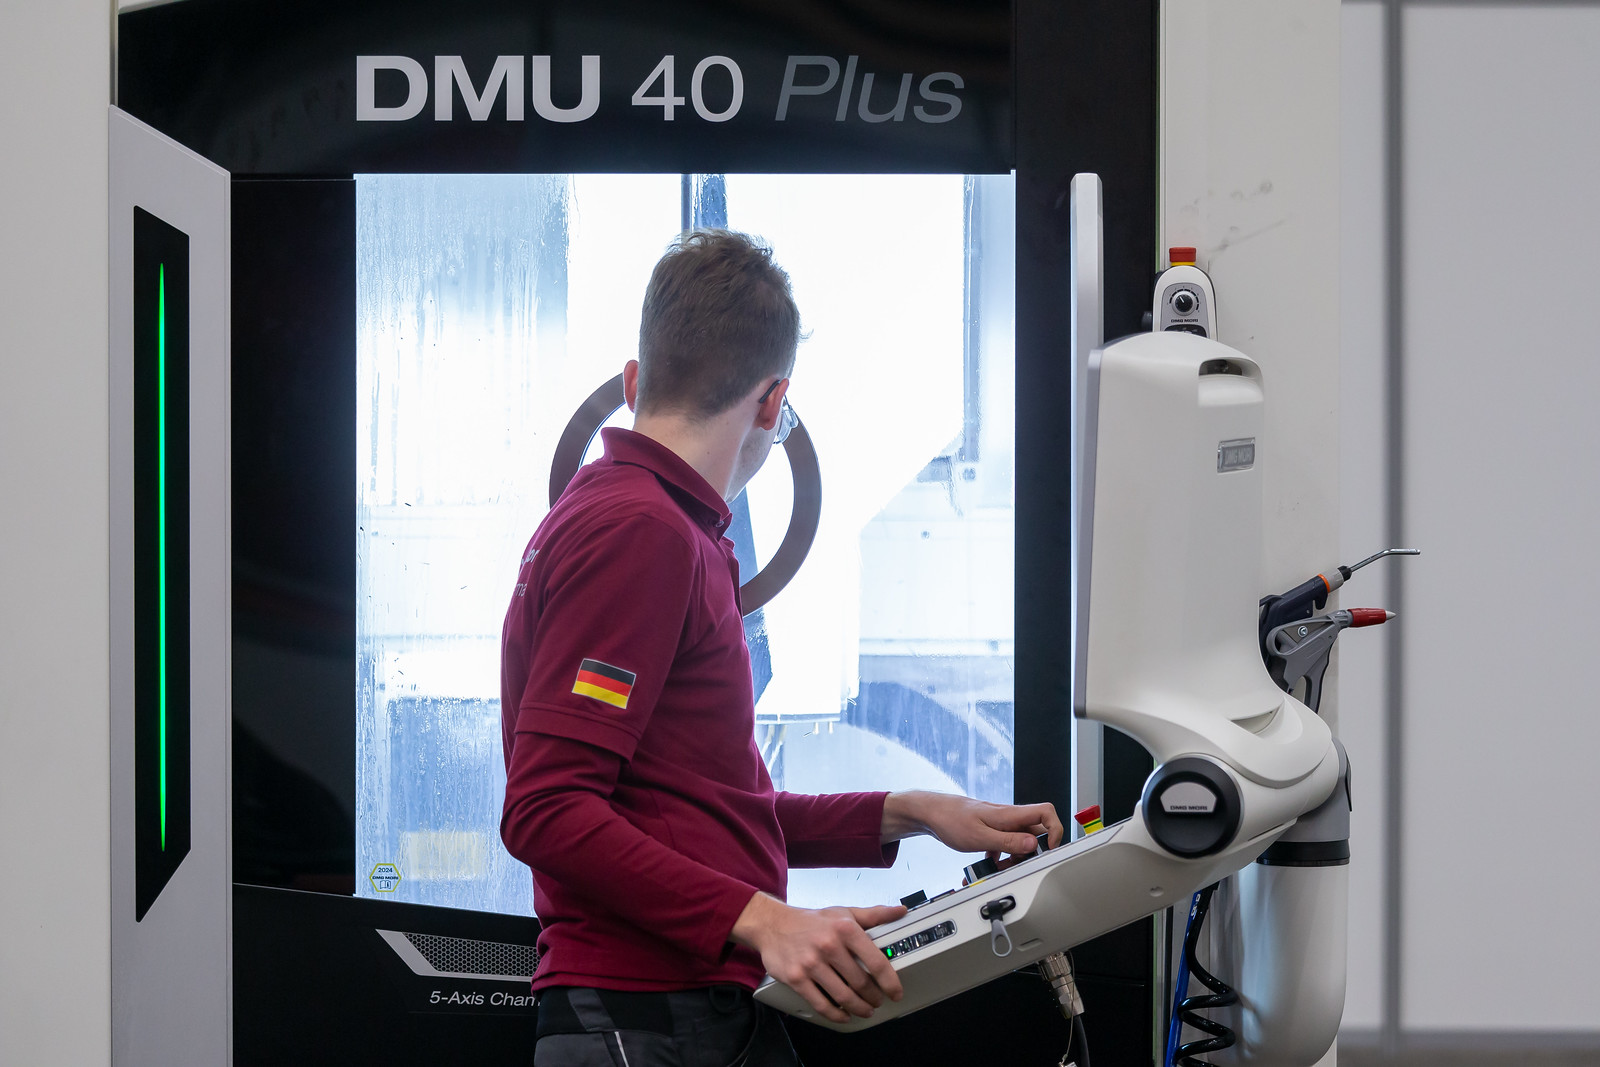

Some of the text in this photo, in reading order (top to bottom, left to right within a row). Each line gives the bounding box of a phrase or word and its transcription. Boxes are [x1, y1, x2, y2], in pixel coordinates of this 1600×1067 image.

[356, 55, 965, 123] DMU 40 Plus
[429, 990, 541, 1007] 5-Axis Cham
